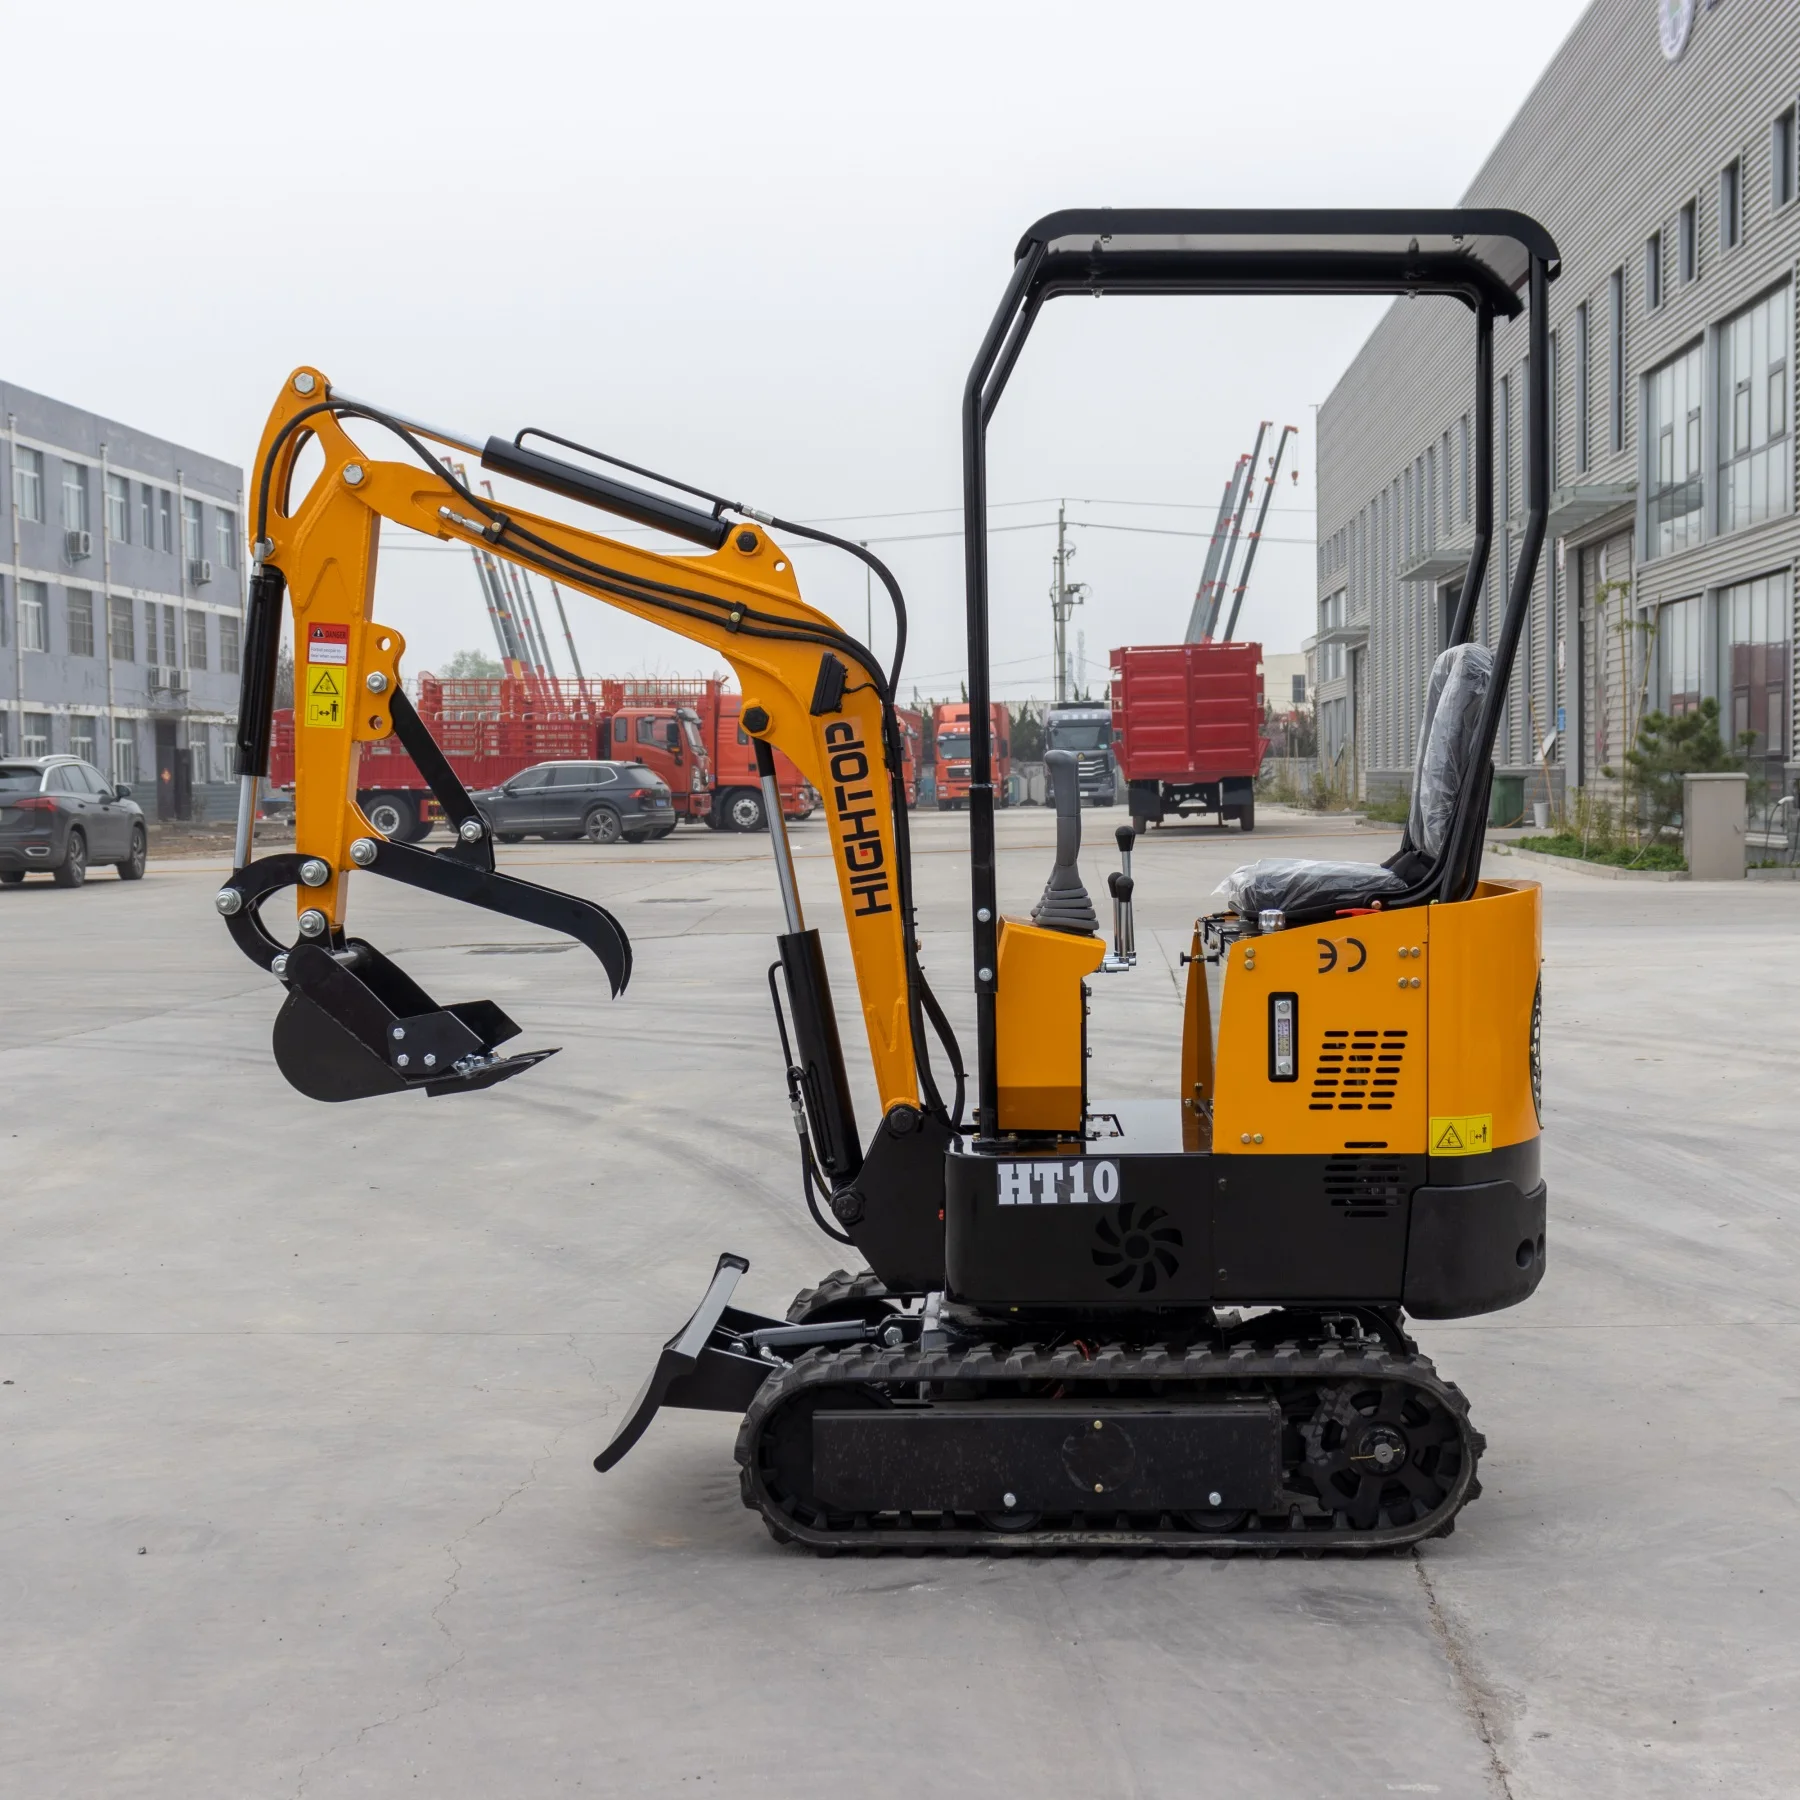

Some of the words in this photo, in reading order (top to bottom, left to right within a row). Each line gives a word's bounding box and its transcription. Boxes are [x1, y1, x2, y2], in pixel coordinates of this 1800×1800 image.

[325, 630, 346, 639] DANGER
[825, 722, 892, 916] HIGHTOP
[998, 1161, 1119, 1204] HT10
